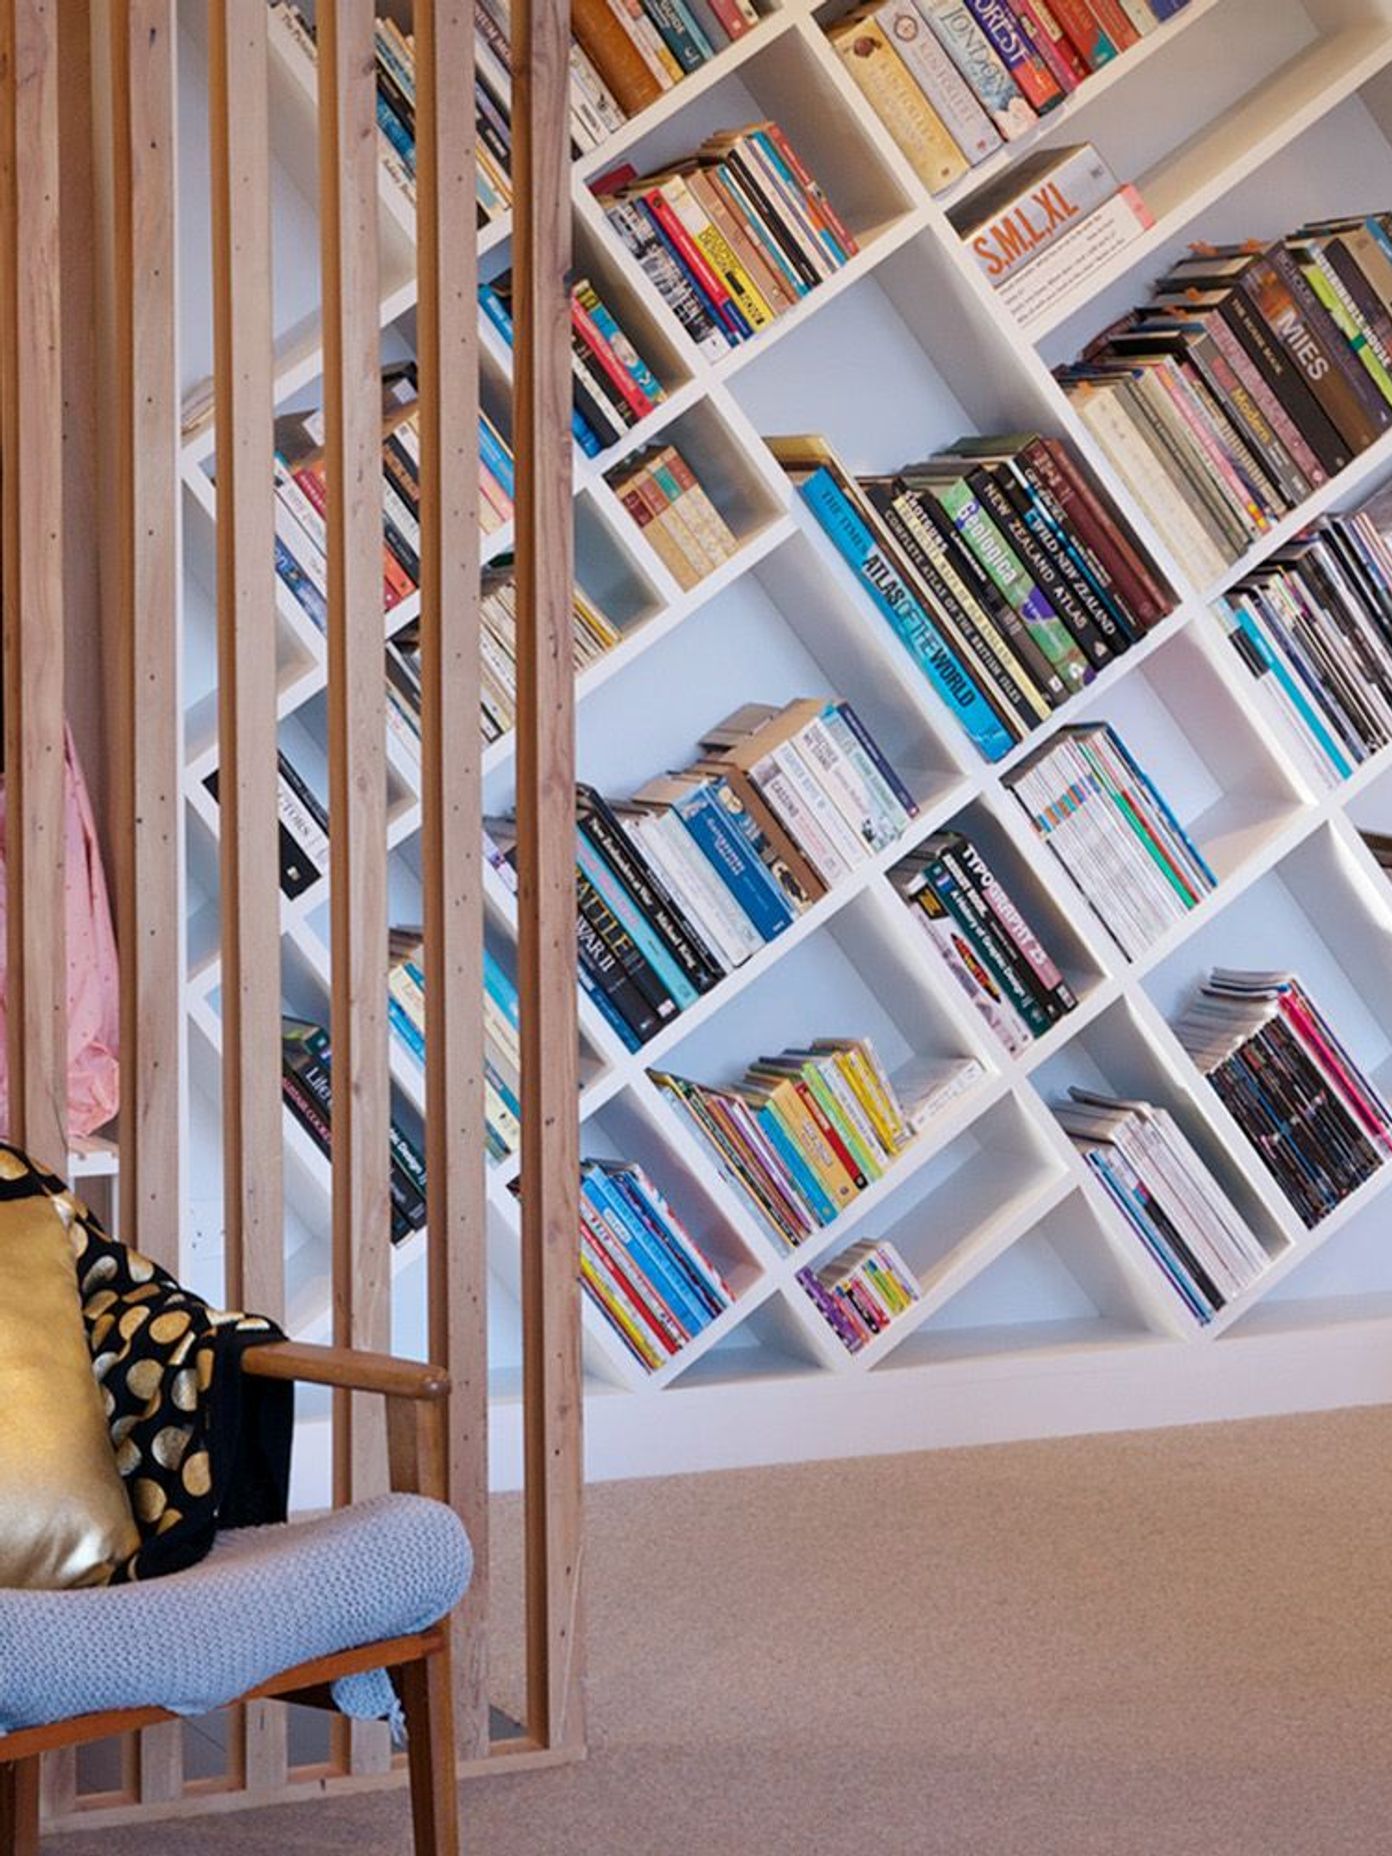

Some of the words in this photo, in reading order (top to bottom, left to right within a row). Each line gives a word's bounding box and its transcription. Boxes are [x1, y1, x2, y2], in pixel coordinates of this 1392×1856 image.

[940, 5, 1012, 97] LONDON
[969, 180, 1080, 277] S,M,L,XL
[1273, 309, 1333, 383] MIES
[1229, 386, 1274, 445] Modern
[954, 499, 1022, 588] Geologica
[981, 481, 1013, 519] NEW
[1006, 517, 1057, 584] ZEALAND
[1051, 582, 1090, 631] ATLAS
[1030, 517, 1060, 554] WILD
[1052, 550, 1080, 584] NEW
[1072, 578, 1117, 637] ZEALAND
[861, 552, 907, 608] ATLAS
[926, 646, 978, 711] WORLD
[881, 507, 926, 567] COMPLETE
[922, 566, 948, 597] ATLAS
[942, 595, 960, 614] OF
[953, 611, 975, 636] THE
[969, 633, 1003, 677] BRITISH
[997, 673, 1023, 705] ISLES
[587, 817, 607, 840] New
[600, 834, 638, 883] Zealanders
[630, 877, 643, 891] at
[564, 867, 636, 961] ATTLE
[636, 885, 656, 908] War
[949, 889, 960, 900] A
[952, 896, 980, 930] History
[958, 841, 1035, 947] TYPOGRAPHY
[569, 914, 609, 962] WAR
[596, 952, 617, 973] II
[653, 909, 684, 947] Michael
[974, 925, 987, 938] of
[978, 934, 1008, 971] Graphic
[675, 943, 699, 971] King
[999, 965, 1028, 1000] Design
[394, 1140, 424, 1178] Design
